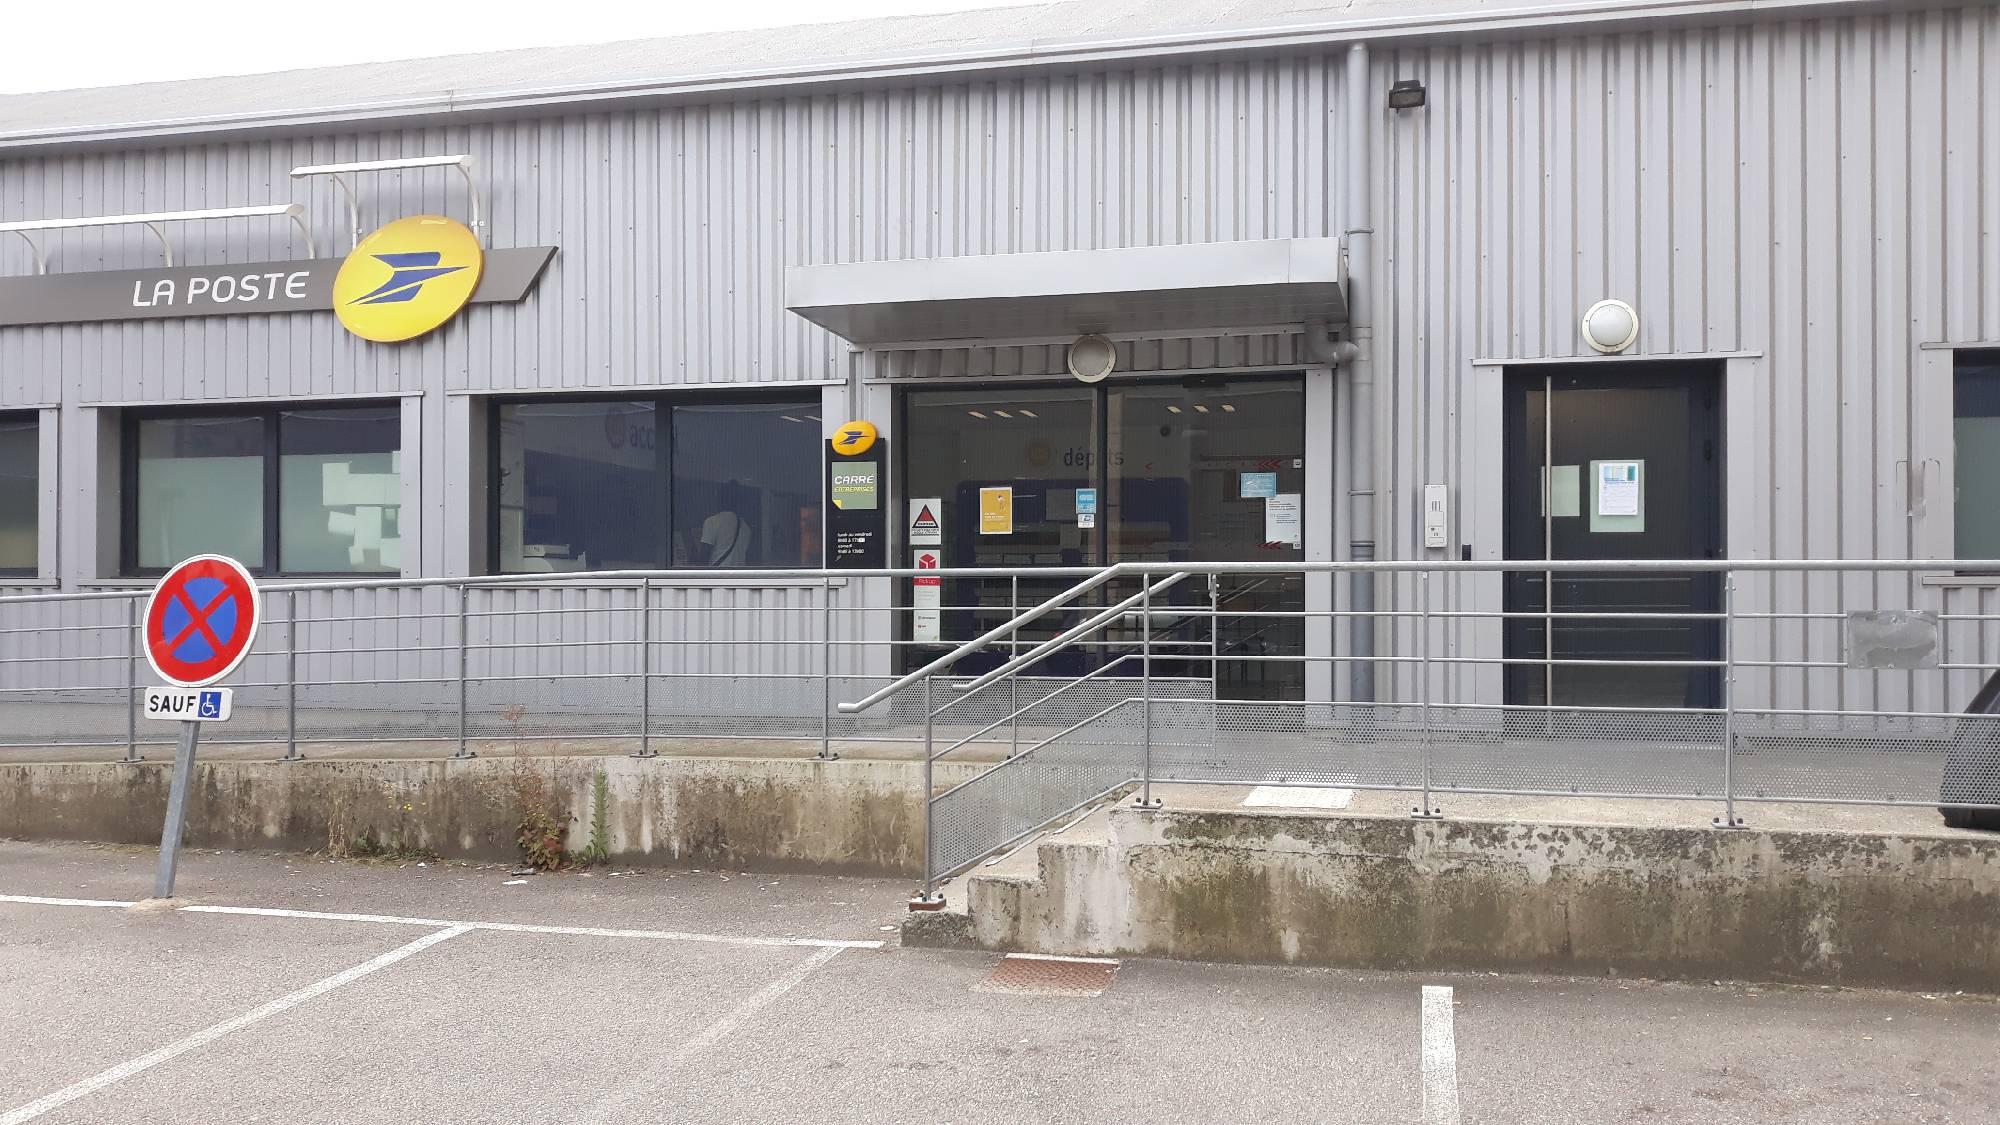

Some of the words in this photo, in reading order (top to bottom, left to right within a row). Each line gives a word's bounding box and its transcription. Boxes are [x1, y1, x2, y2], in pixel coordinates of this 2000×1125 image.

[133, 279, 175, 307] LA
[187, 271, 311, 305] POSTE
[1064, 446, 1125, 470] dépts
[149, 694, 197, 713] SAUF
